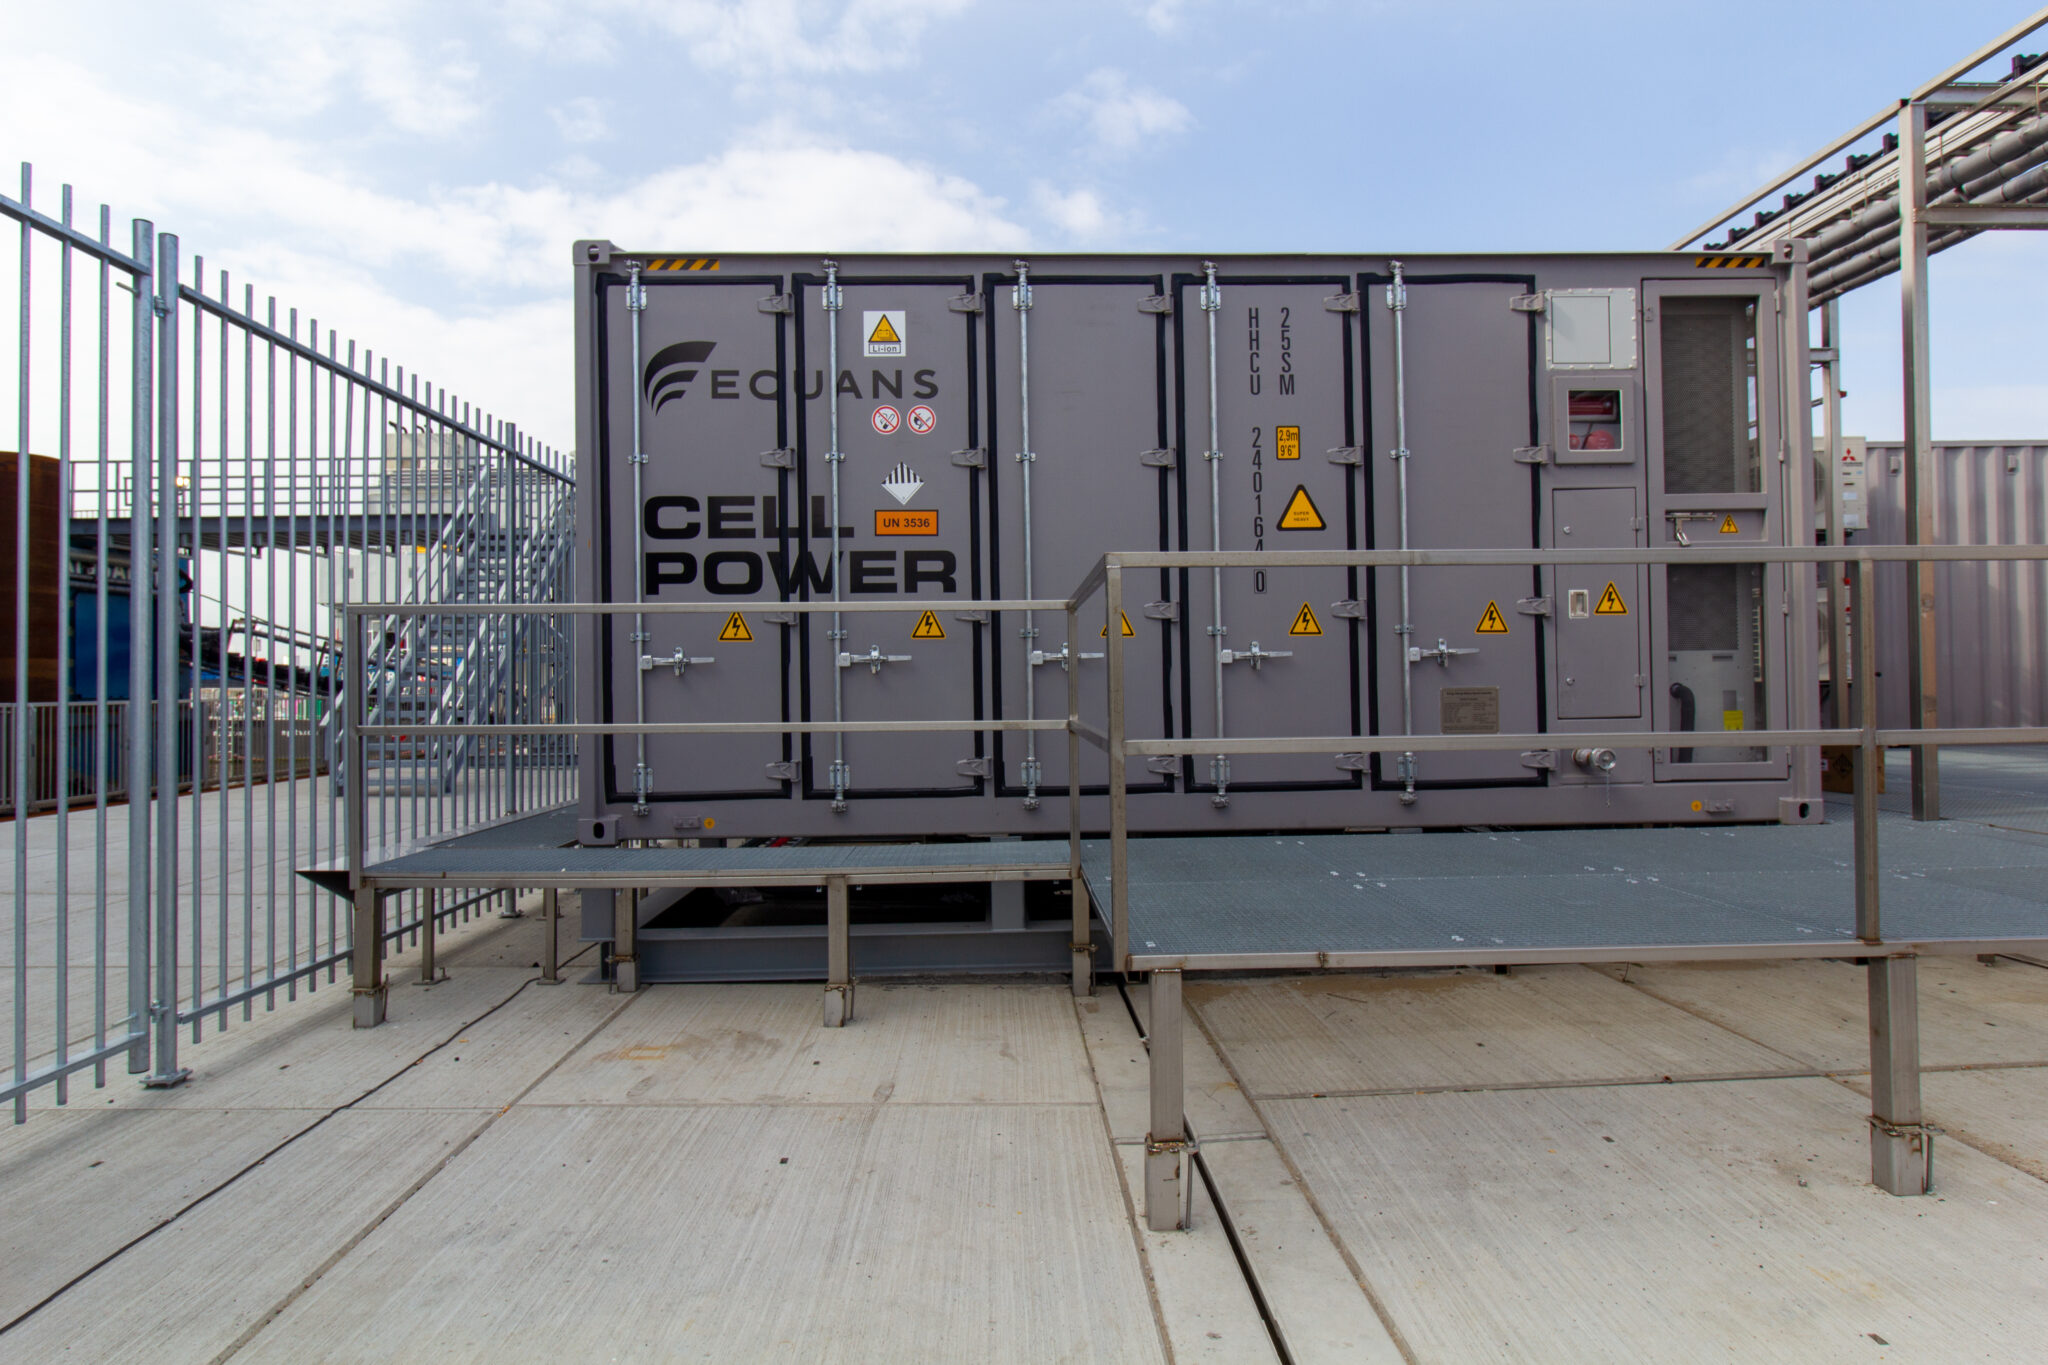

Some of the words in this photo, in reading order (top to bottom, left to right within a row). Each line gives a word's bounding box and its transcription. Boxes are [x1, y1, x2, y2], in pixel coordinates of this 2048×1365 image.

[872, 345, 897, 353] Li-ion
[1248, 307, 1261, 395] HHCU
[1279, 307, 1295, 395] 25SM
[1279, 430, 1298, 443] 2,9m
[644, 495, 855, 539] CELL
[883, 518, 900, 528] UN
[903, 518, 931, 528] 3536
[645, 550, 957, 596] POWER
